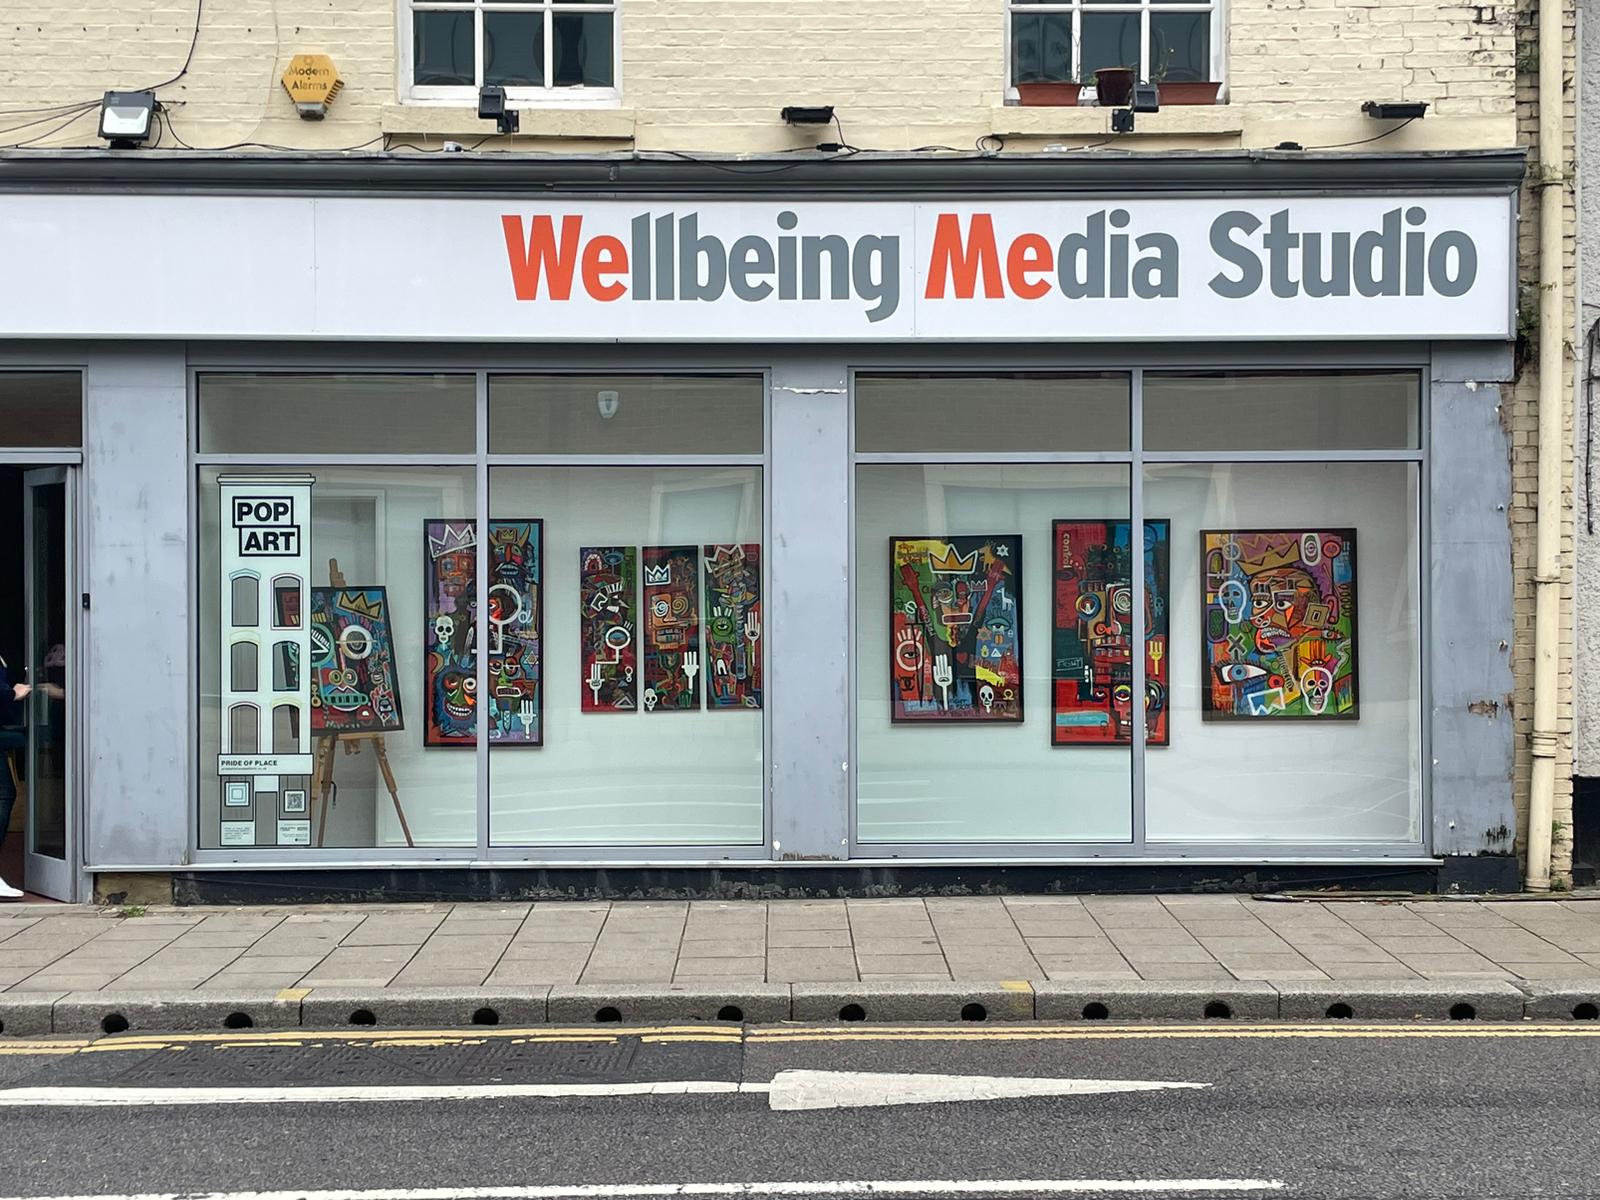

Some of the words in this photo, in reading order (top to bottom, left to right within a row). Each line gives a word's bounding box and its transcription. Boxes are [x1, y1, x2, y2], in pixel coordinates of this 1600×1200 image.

[288, 66, 330, 76] Modern
[292, 80, 328, 90] Alarms
[501, 211, 900, 323] Wellbeing
[925, 208, 1179, 300] Media
[1207, 207, 1478, 299] Studio
[237, 502, 290, 522] POP
[244, 532, 297, 551] ART
